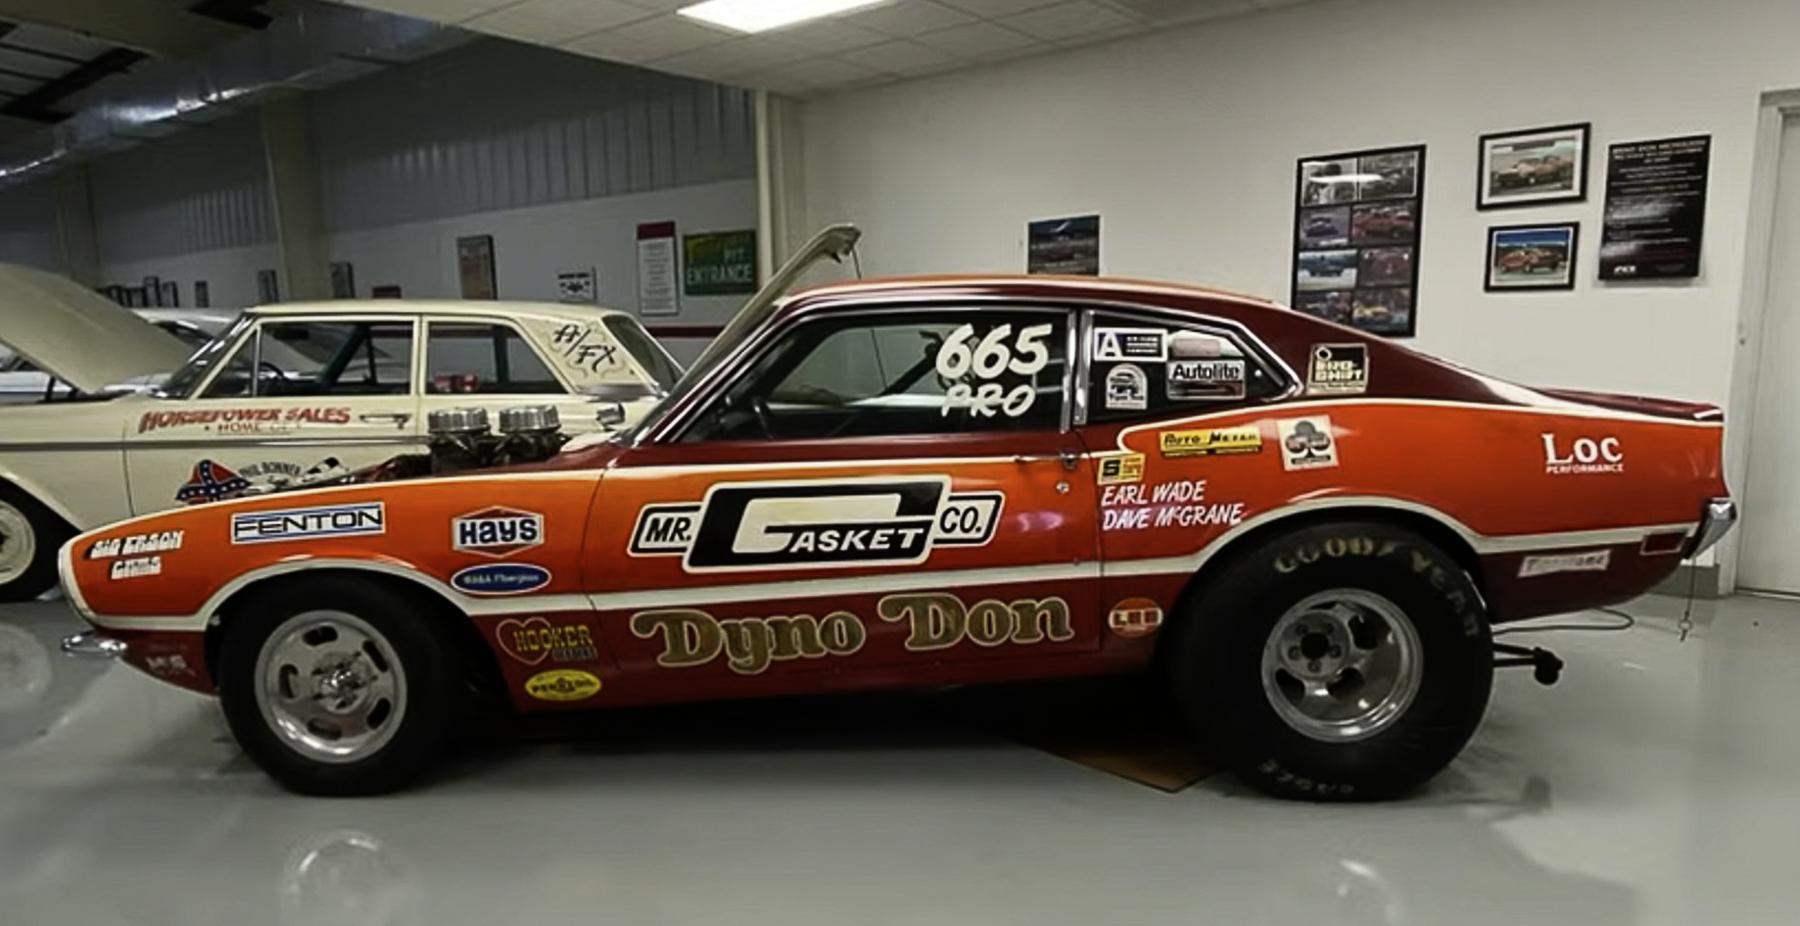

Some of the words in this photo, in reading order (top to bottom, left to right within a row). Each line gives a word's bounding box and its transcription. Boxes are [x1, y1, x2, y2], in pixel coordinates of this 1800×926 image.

[686, 264, 753, 285] ENTRANCE
[936, 323, 1053, 379] 665
[1172, 363, 1241, 380] Autolite
[941, 383, 1035, 417] PRO
[285, 406, 351, 424] SALES
[1546, 463, 1624, 474] PERFORMANCE
[1101, 484, 1148, 506] EARL
[1153, 480, 1207, 503] WADE
[234, 507, 383, 538] FENTON
[645, 517, 692, 543] MR.
[731, 494, 924, 553] GASKET
[939, 506, 983, 534] CO.
[1103, 508, 1151, 531] DAVE
[513, 624, 593, 652] HOOKER
[630, 610, 866, 674] Dyno
[877, 593, 1074, 651] Don
